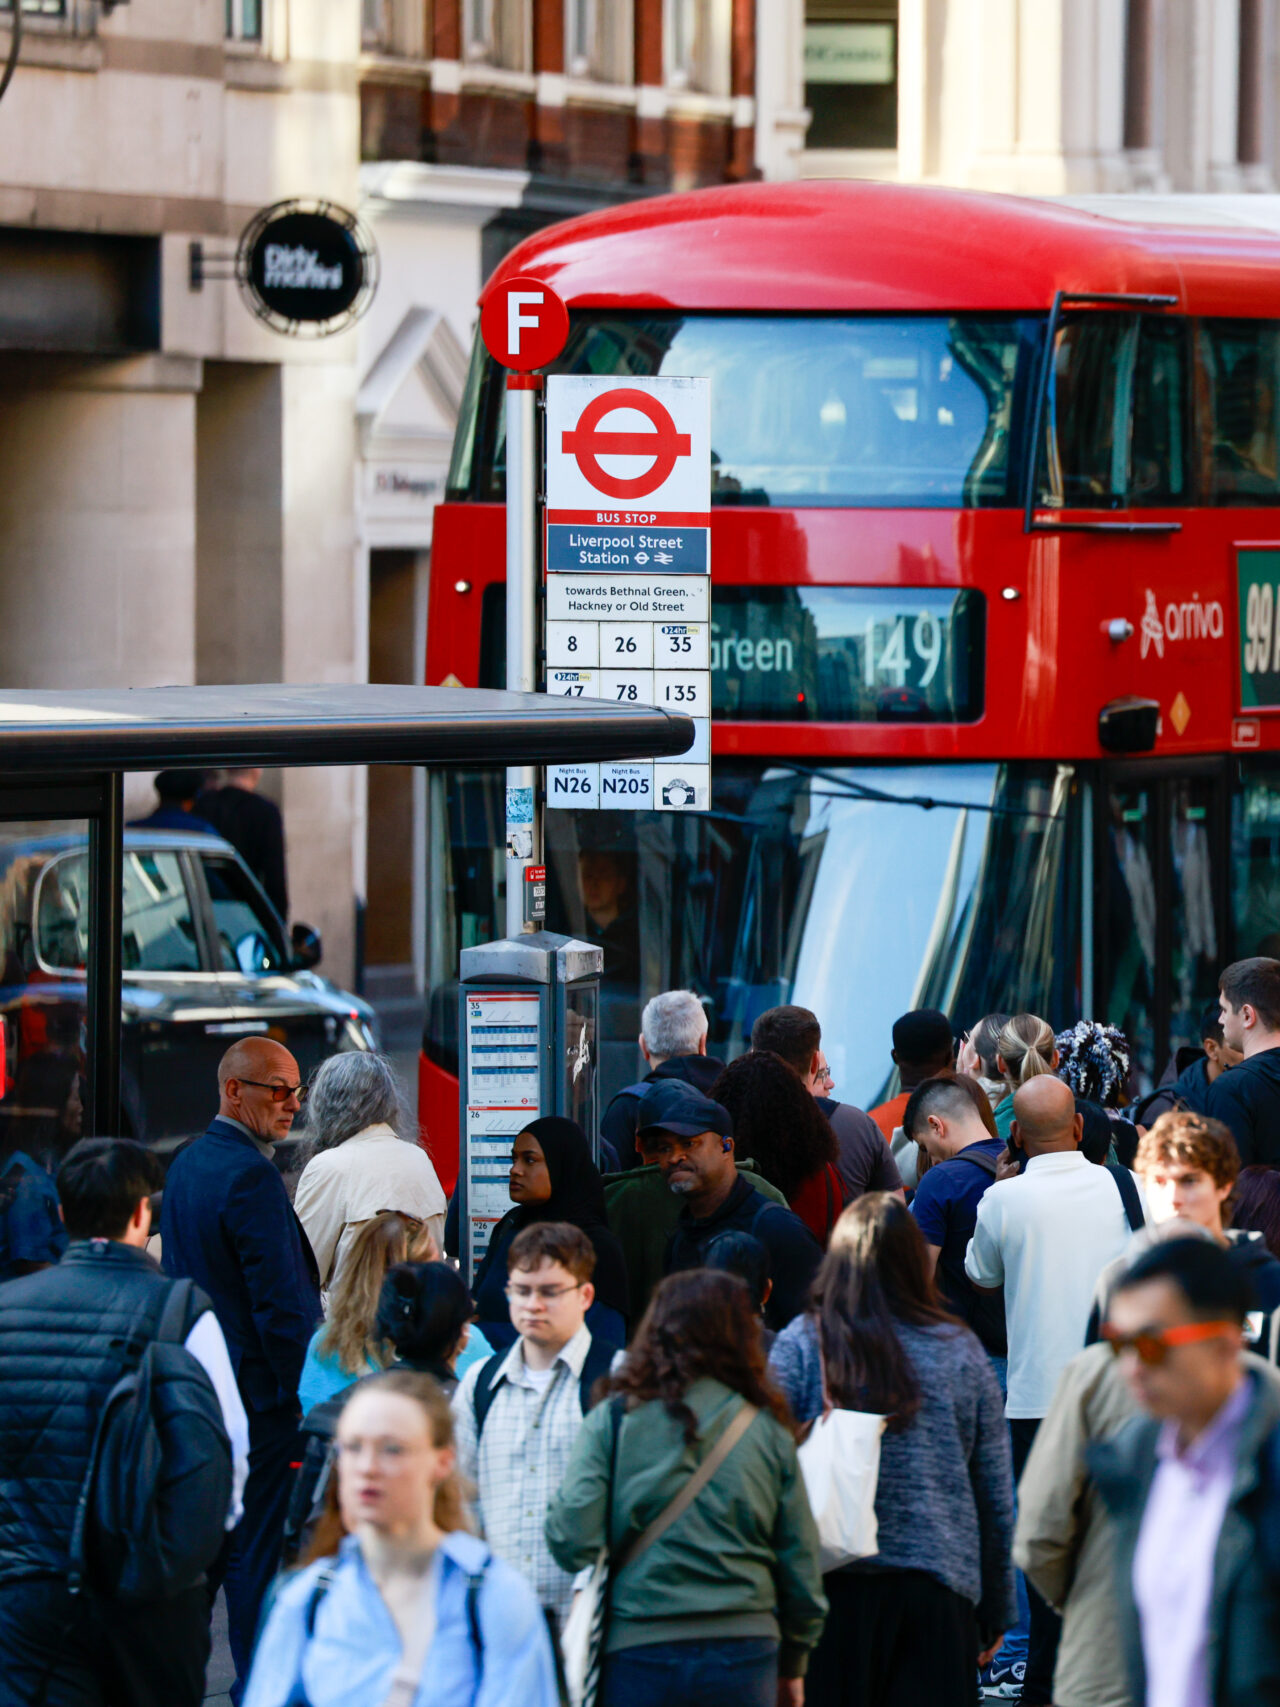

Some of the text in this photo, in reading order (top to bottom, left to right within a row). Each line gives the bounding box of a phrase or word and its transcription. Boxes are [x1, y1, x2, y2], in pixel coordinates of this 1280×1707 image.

[507, 291, 544, 355] F
[596, 513, 657, 524] BUS STOP
[569, 533, 683, 550] Liverpool Street
[579, 550, 629, 565] Station
[565, 586, 607, 596] towards
[610, 586, 650, 597] Bethnal
[568, 601, 685, 612] Hackney or Old Street
[1164, 591, 1224, 641] arriva
[668, 626, 687, 635] 24hr
[1244, 582, 1274, 673] 99
[567, 635, 578, 651] 8
[614, 636, 637, 653] 26
[669, 636, 692, 653] 35
[864, 609, 942, 688] 149
[560, 673, 579, 681] 24hr
[616, 684, 638, 701] 78
[665, 685, 697, 701] 135
[554, 777, 592, 793] N26
[602, 778, 650, 794] N205
[471, 1002, 480, 1010] 35
